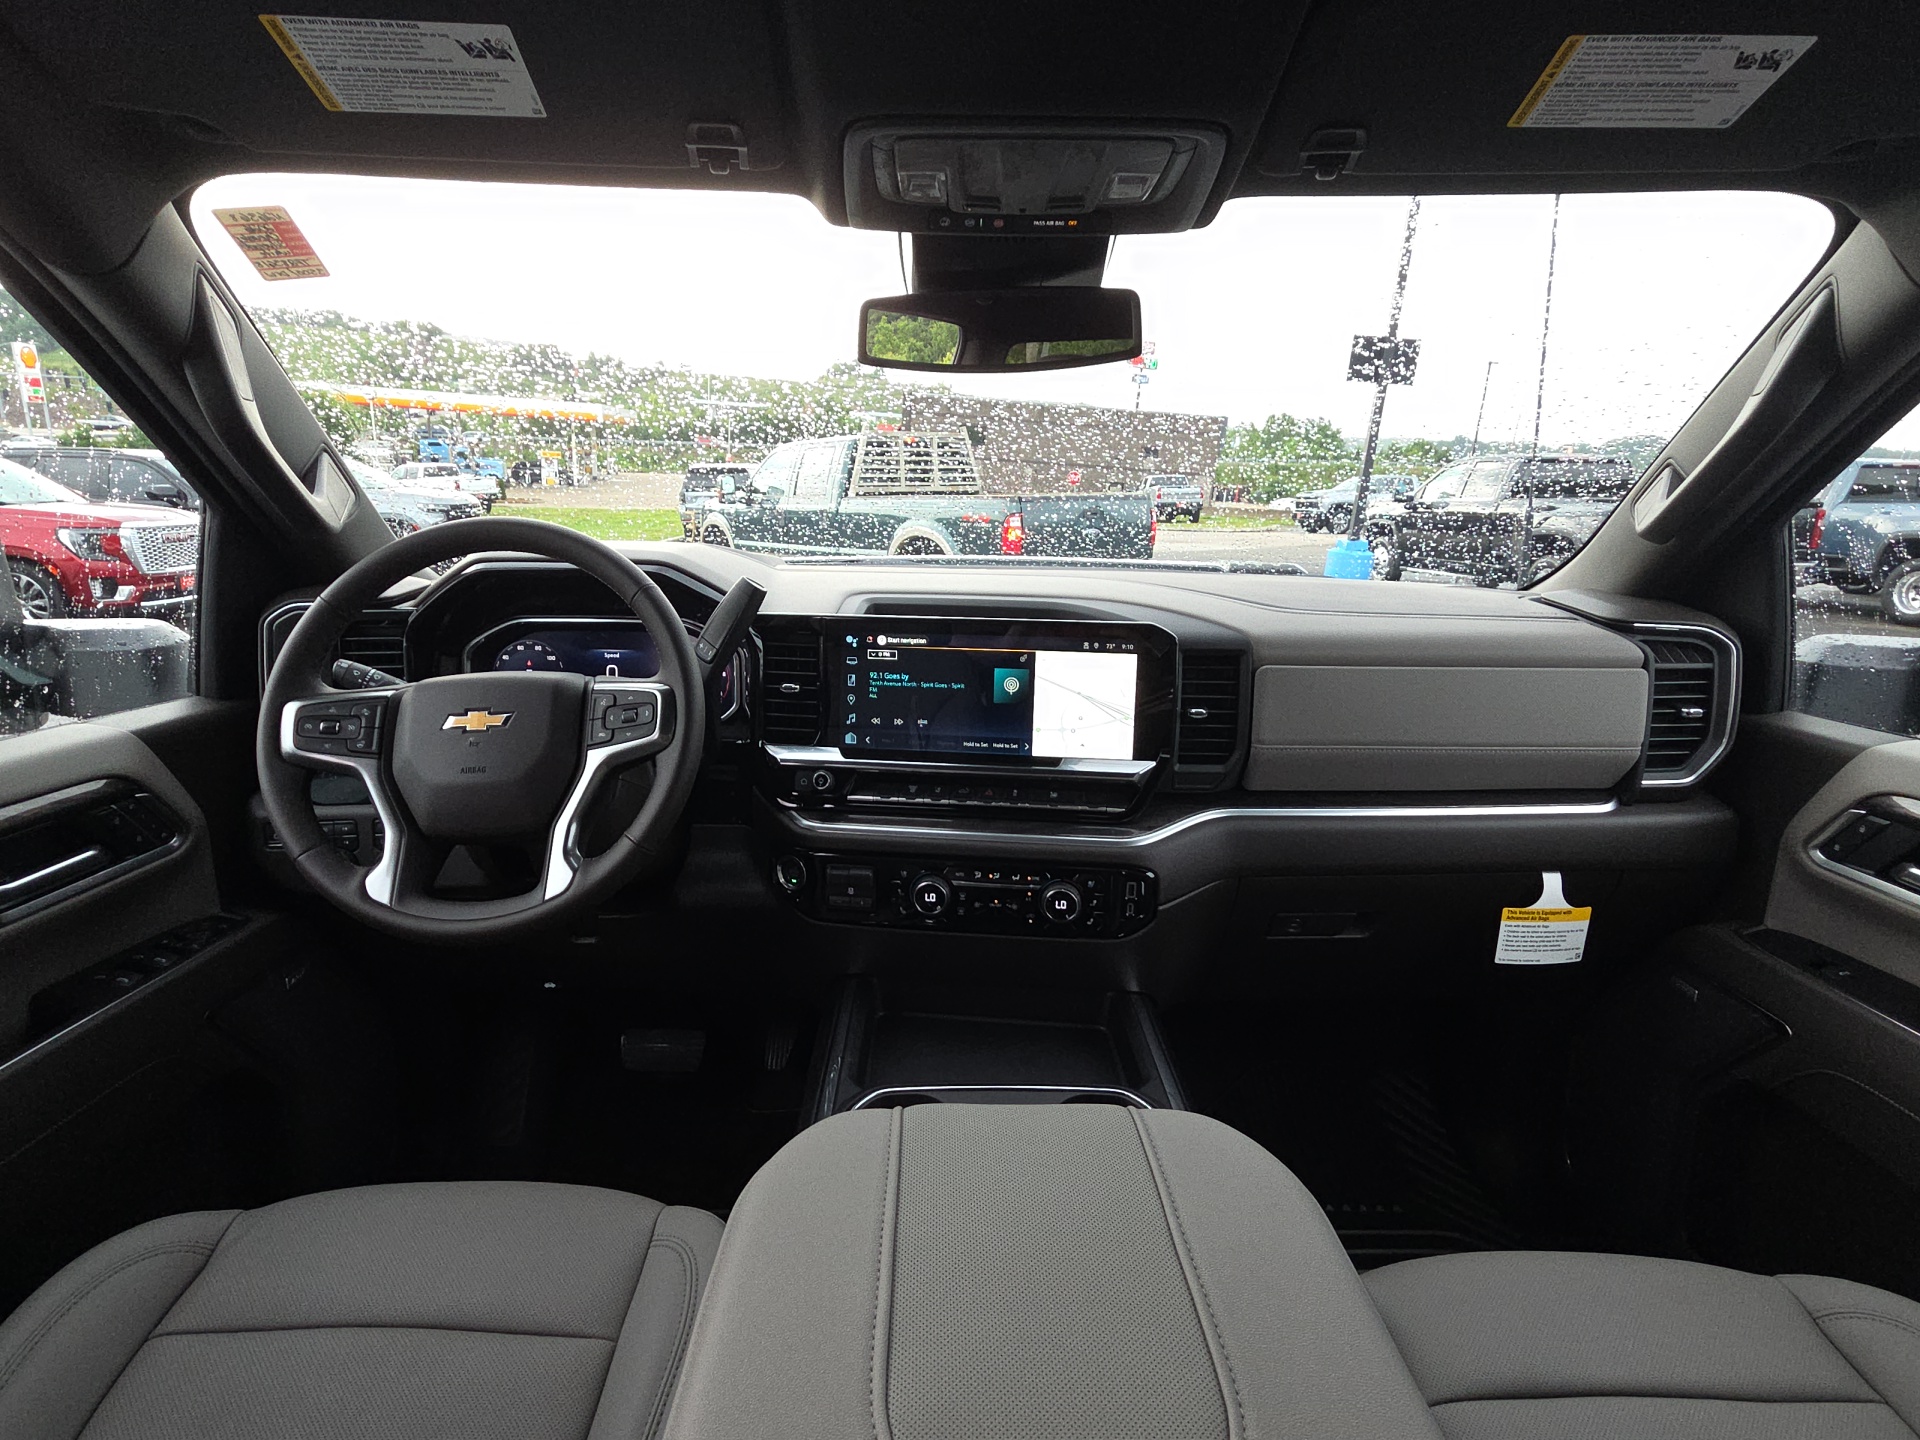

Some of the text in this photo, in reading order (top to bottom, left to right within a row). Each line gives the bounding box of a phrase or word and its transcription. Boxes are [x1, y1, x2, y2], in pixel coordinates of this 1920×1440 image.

[331, 20, 377, 28] ADVANCED
[900, 637, 927, 645] navigation
[869, 671, 909, 681] 92.1 Goes by
[920, 681, 934, 689] Spirit
[951, 682, 965, 690] Spirit
[460, 766, 487, 774] AIRBAG
[924, 892, 937, 903] LO
[1055, 900, 1067, 910] LO
